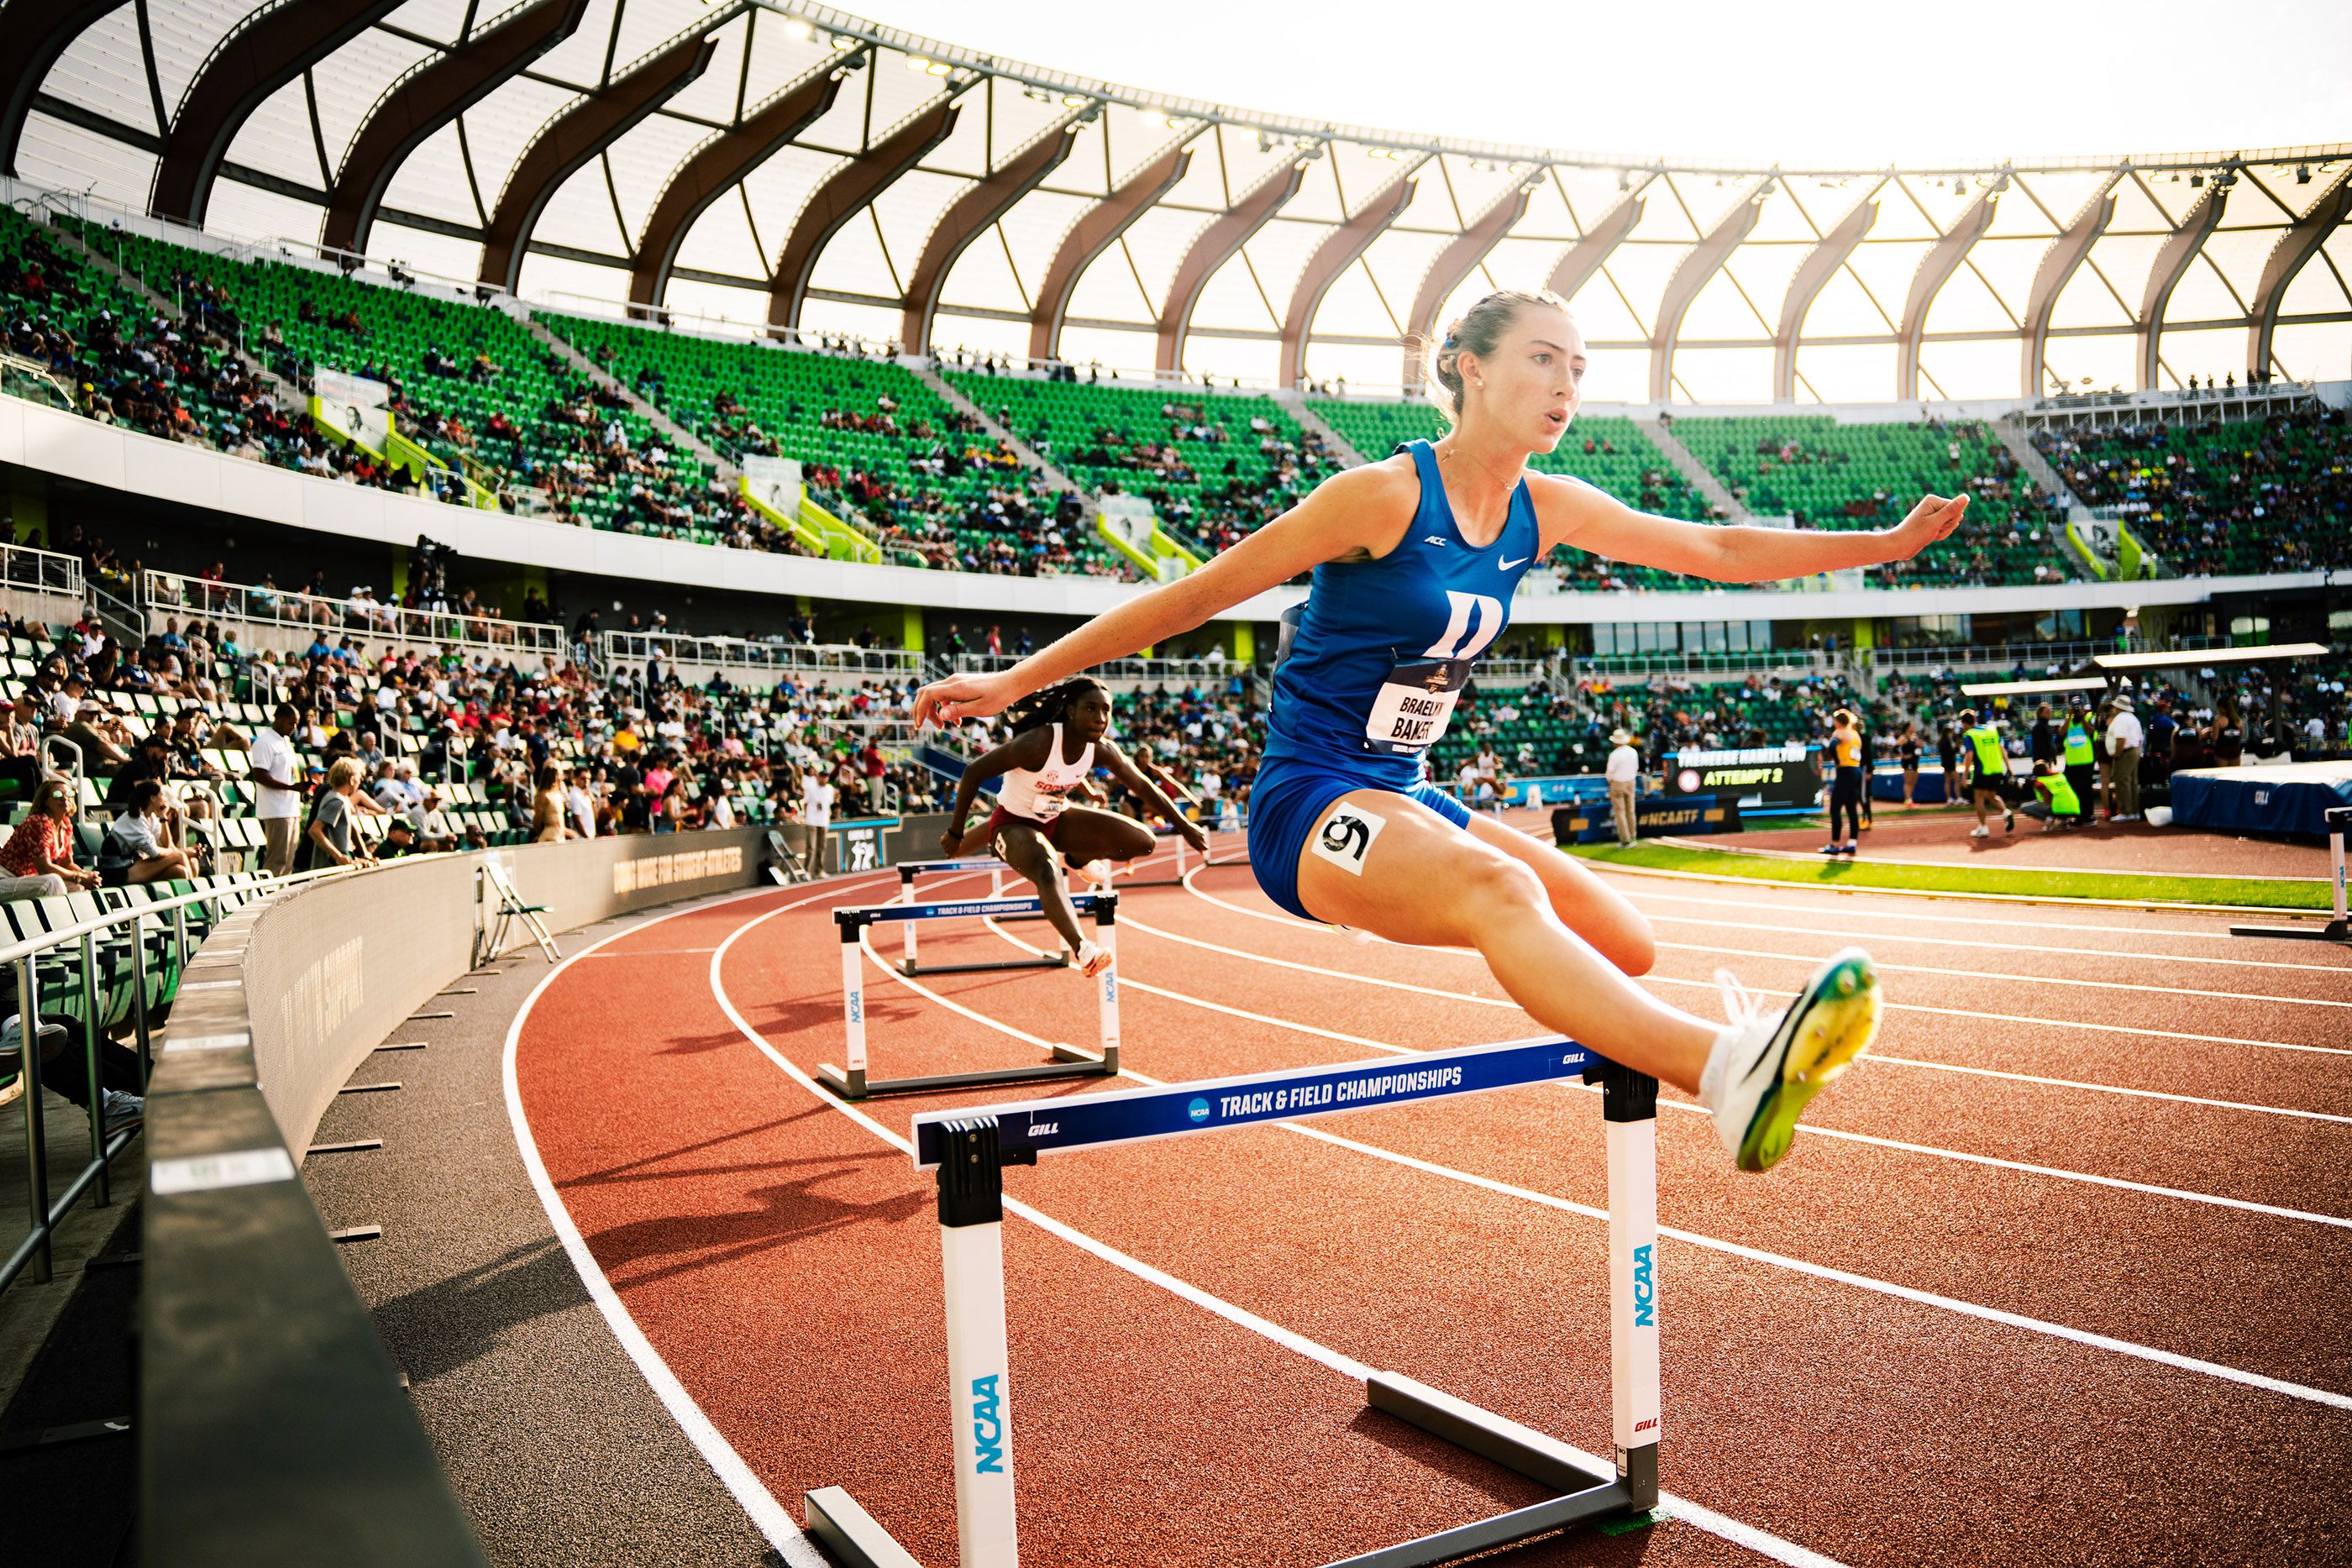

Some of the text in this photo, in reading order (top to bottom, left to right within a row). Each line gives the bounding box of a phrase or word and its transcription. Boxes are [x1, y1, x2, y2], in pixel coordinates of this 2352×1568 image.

[1424, 536, 1447, 547] ACC
[1704, 768, 1783, 786] ATTEMPT 2
[1639, 809, 1699, 826] #NCAATF
[1105, 972, 1115, 1004] NCAA
[850, 991, 861, 1024] NCAA
[1562, 1052, 1585, 1065] GILL
[1190, 1067, 1462, 1119] NCAA TRACK & FIELD CHAMPIONSHIPS
[1027, 1122, 1059, 1137] GILL
[1634, 1244, 1653, 1327] NCAA
[972, 1374, 1003, 1474] NCAA
[1634, 1417, 1658, 1433] GILL
